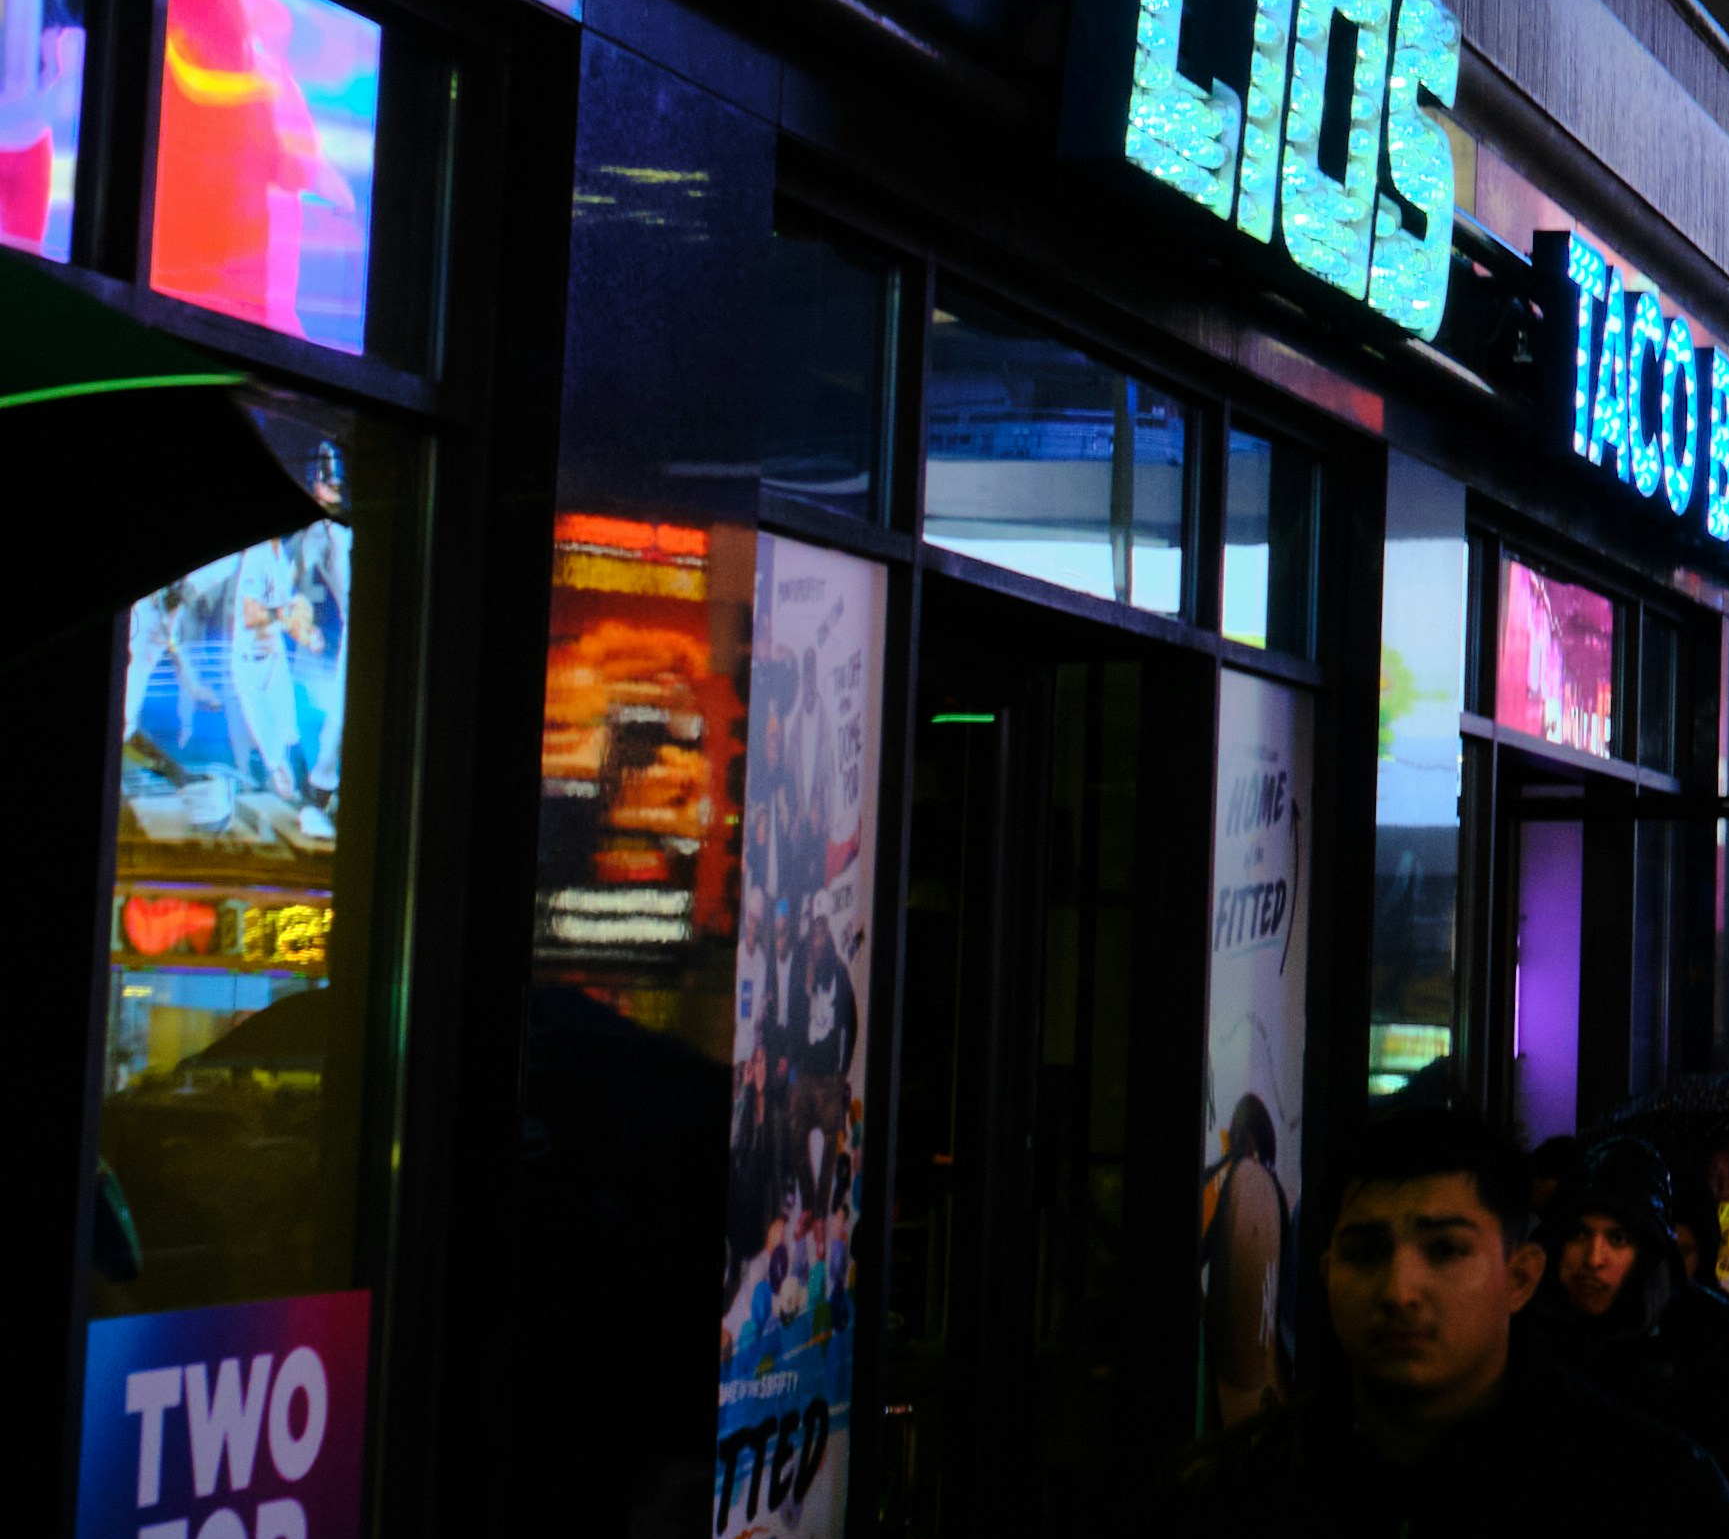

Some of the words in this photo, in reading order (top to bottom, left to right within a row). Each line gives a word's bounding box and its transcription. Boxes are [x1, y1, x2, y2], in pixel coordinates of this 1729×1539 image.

[1565, 230, 1697, 516] TACO
[1214, 878, 1287, 951] FITTED
[125, 1345, 329, 1509] TWO
